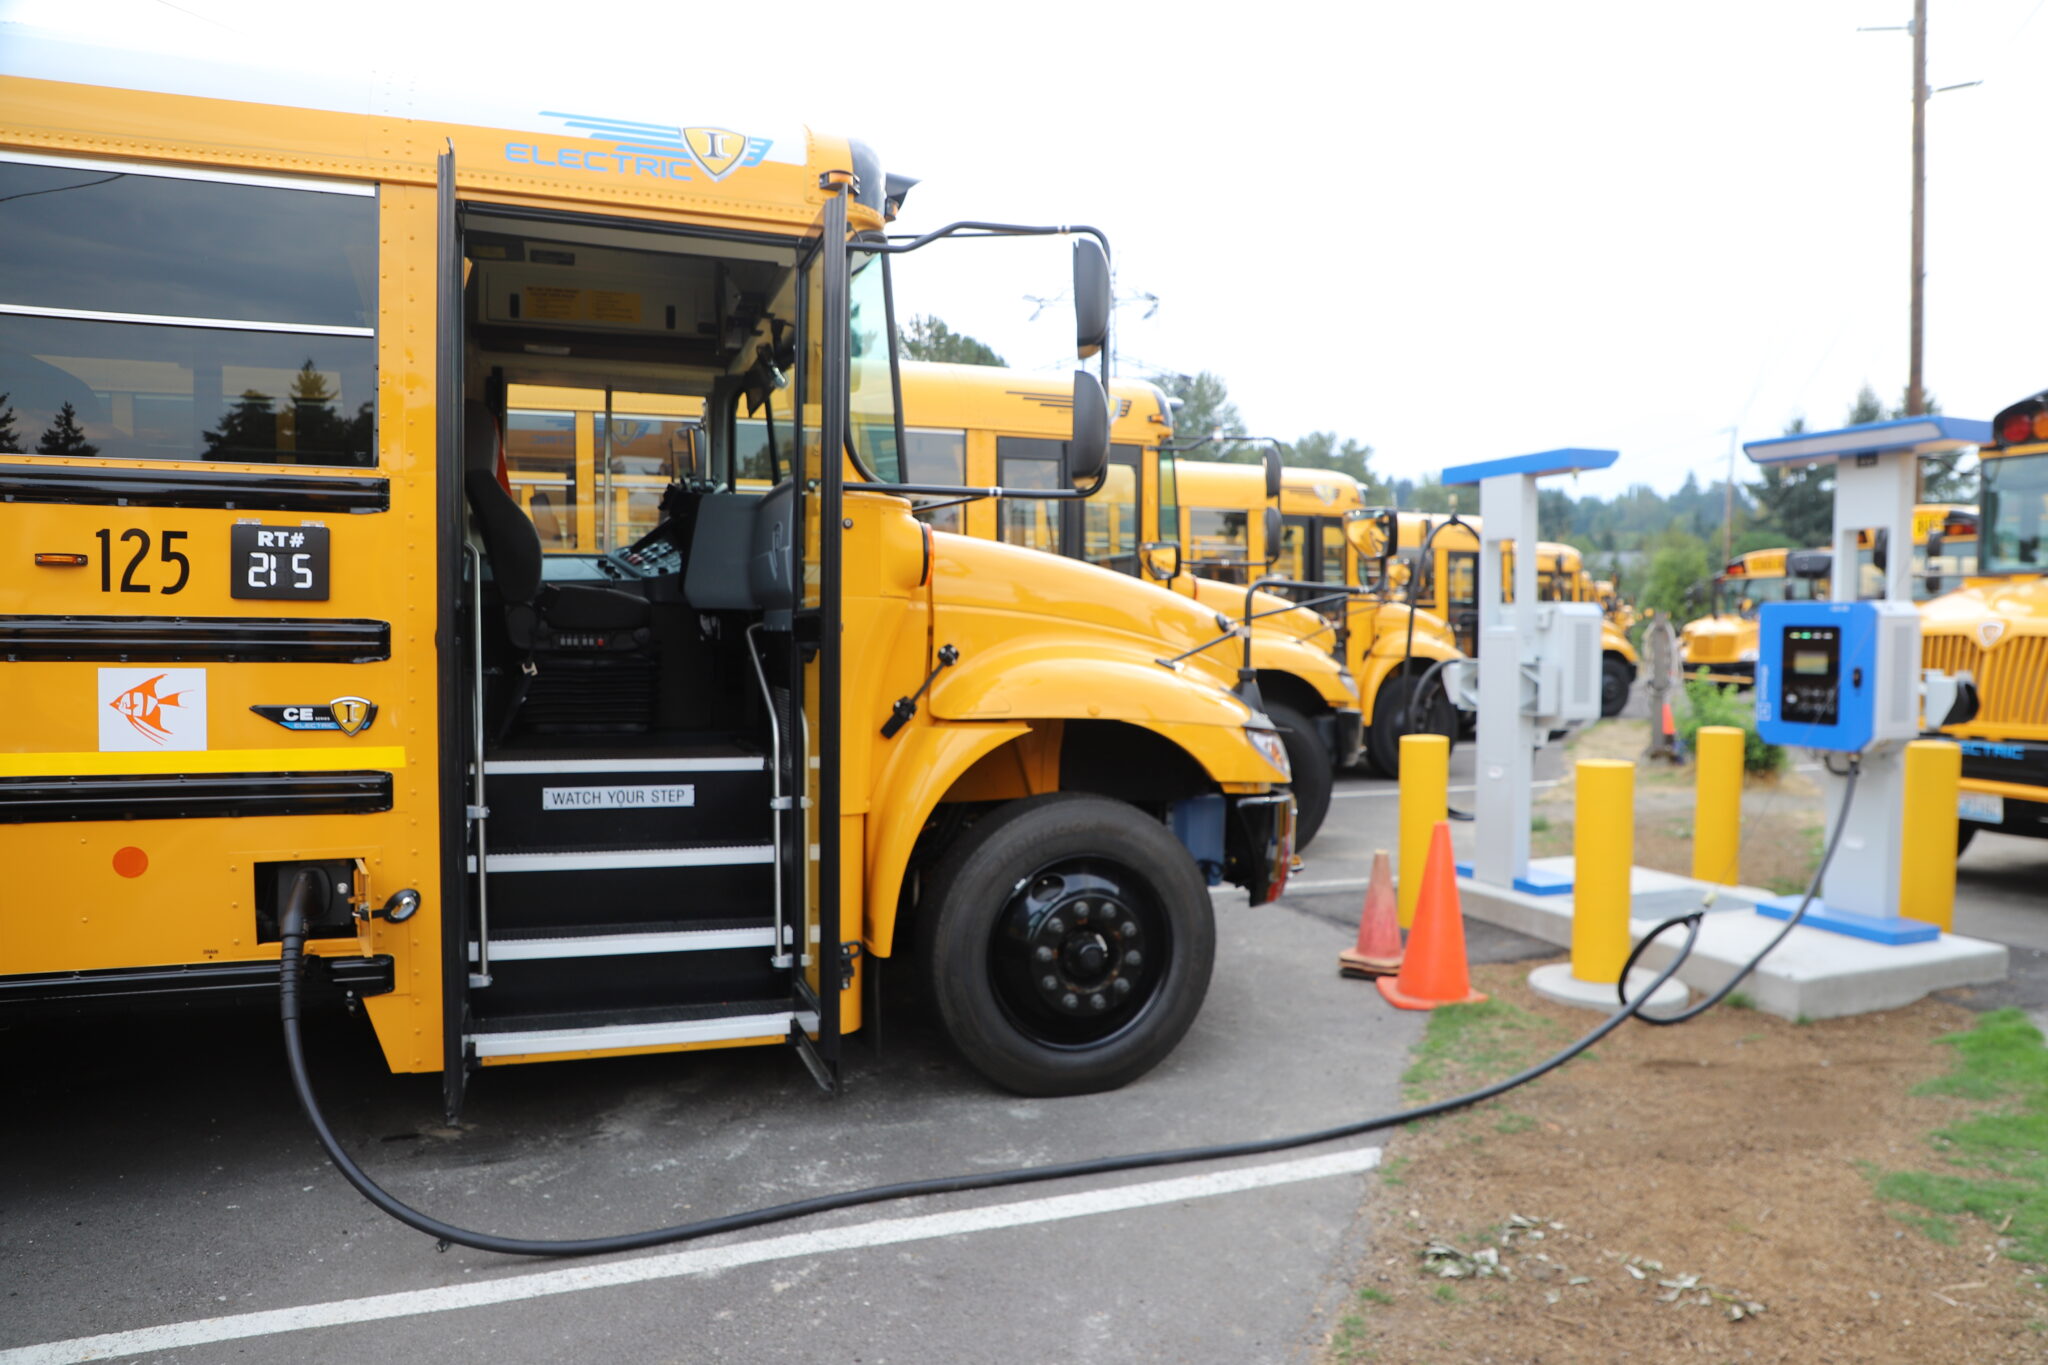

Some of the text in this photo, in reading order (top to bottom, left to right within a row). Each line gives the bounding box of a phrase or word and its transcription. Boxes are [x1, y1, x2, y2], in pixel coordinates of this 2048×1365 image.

[504, 142, 693, 181] ELECTRIC
[257, 530, 305, 548] RT#
[95, 527, 190, 595] 125
[283, 707, 314, 722] CE
[552, 789, 686, 806] WATCH YOUR STEP
